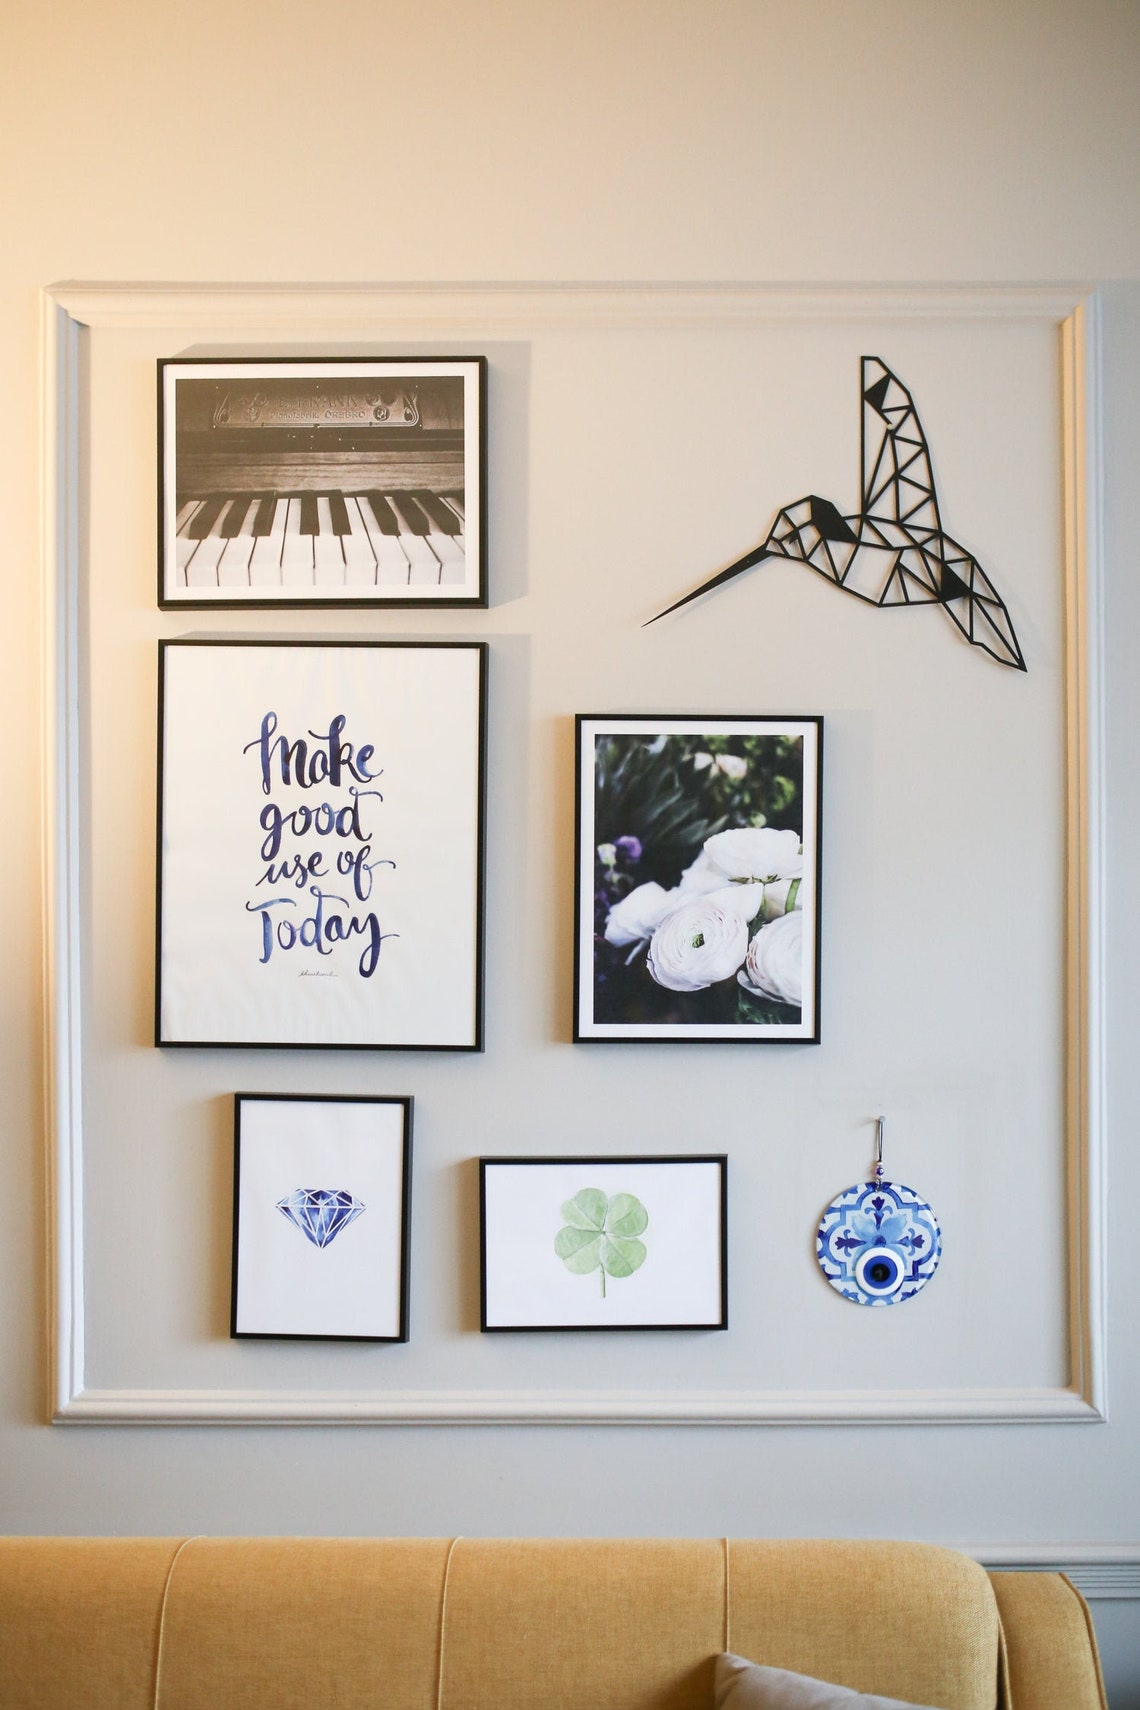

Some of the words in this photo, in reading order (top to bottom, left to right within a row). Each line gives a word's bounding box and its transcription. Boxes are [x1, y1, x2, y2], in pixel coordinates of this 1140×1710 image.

[324, 408, 366, 419] ÖREBRO
[259, 786, 383, 862] good
[255, 851, 329, 889] use
[336, 845, 396, 902] of
[244, 885, 401, 978] Today
